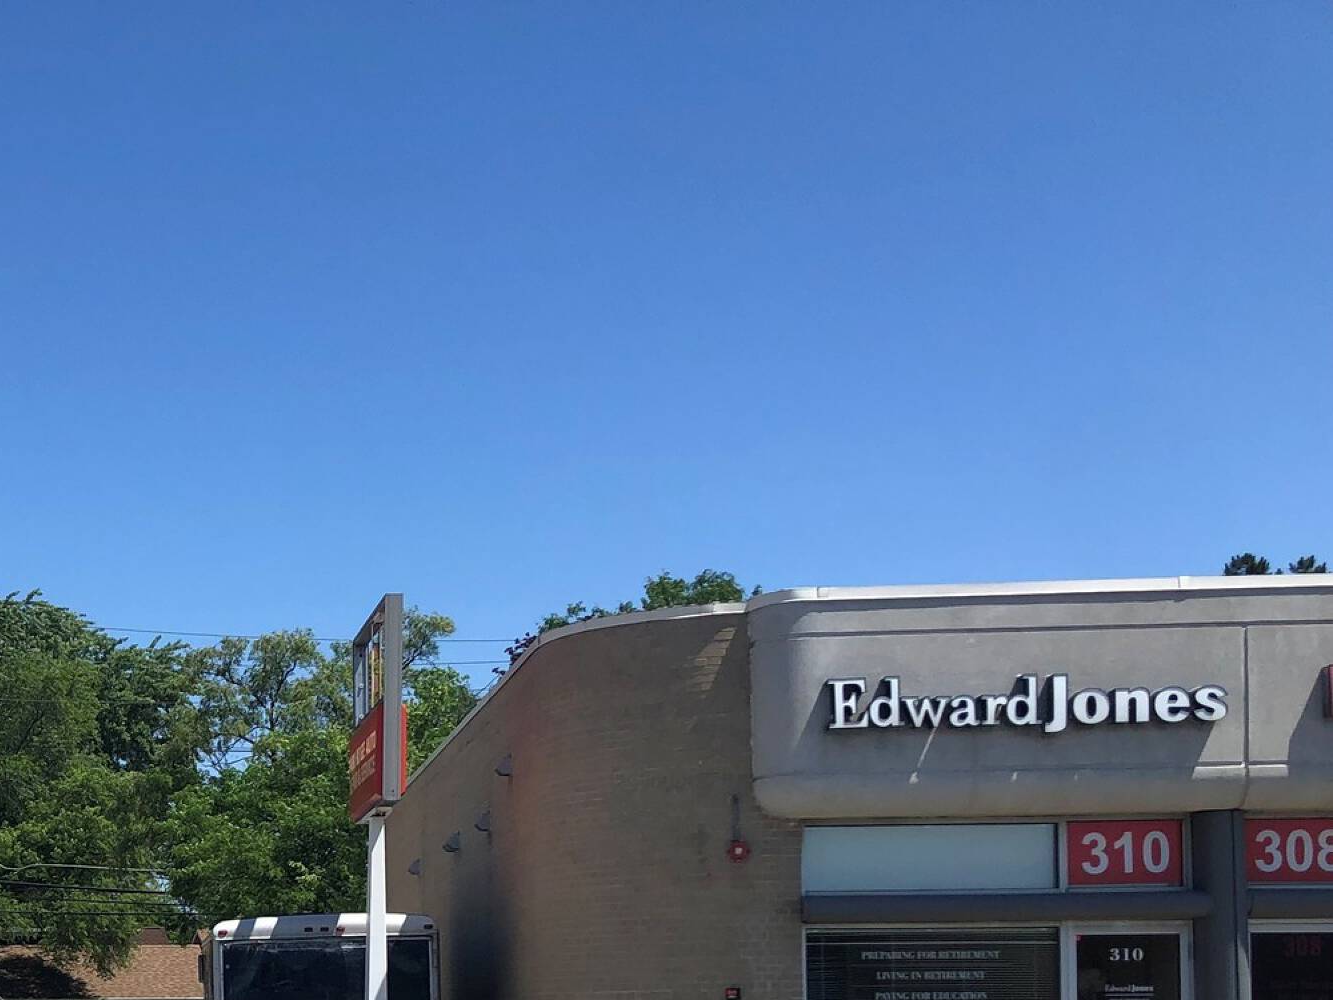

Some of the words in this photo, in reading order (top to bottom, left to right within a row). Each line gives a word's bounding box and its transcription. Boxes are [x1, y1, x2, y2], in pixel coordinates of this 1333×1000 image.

[1081, 831, 1170, 875] 310
[1255, 829, 1333, 873] 308
[861, 951, 915, 960] PREPARING
[917, 951, 937, 960] FOR
[938, 951, 1001, 960] RETIREMENT
[1109, 947, 1144, 961] 310
[876, 971, 909, 980] LIVING
[911, 971, 922, 980] IN
[923, 971, 986, 980] RETIREMENT
[875, 992, 910, 1000] PAYING
[911, 992, 931, 1000] FOR
[933, 992, 987, 1000] EDUCATION
